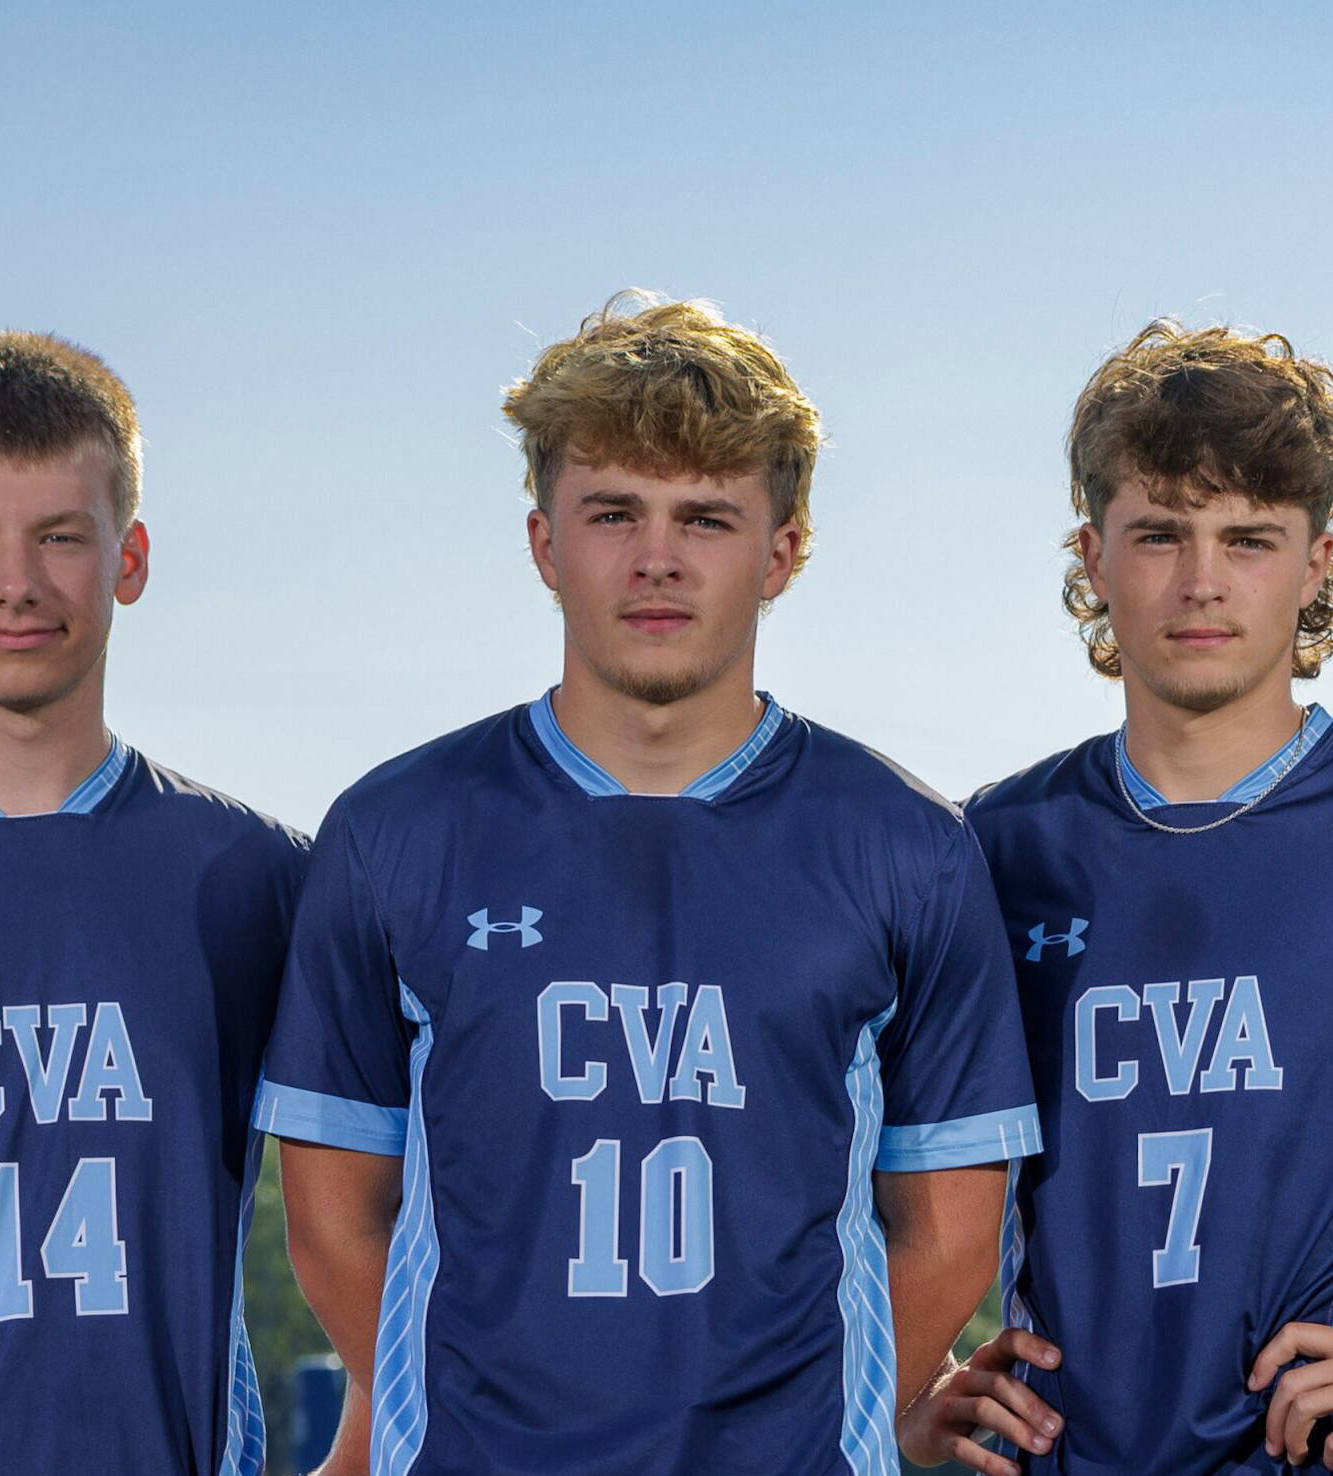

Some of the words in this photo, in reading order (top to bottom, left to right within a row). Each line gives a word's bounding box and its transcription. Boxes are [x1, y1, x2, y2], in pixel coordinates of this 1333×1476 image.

[537, 981, 746, 1109] CVA
[1075, 975, 1283, 1102] CVA
[568, 1136, 715, 1298] 10
[1137, 1127, 1213, 1289] 7
